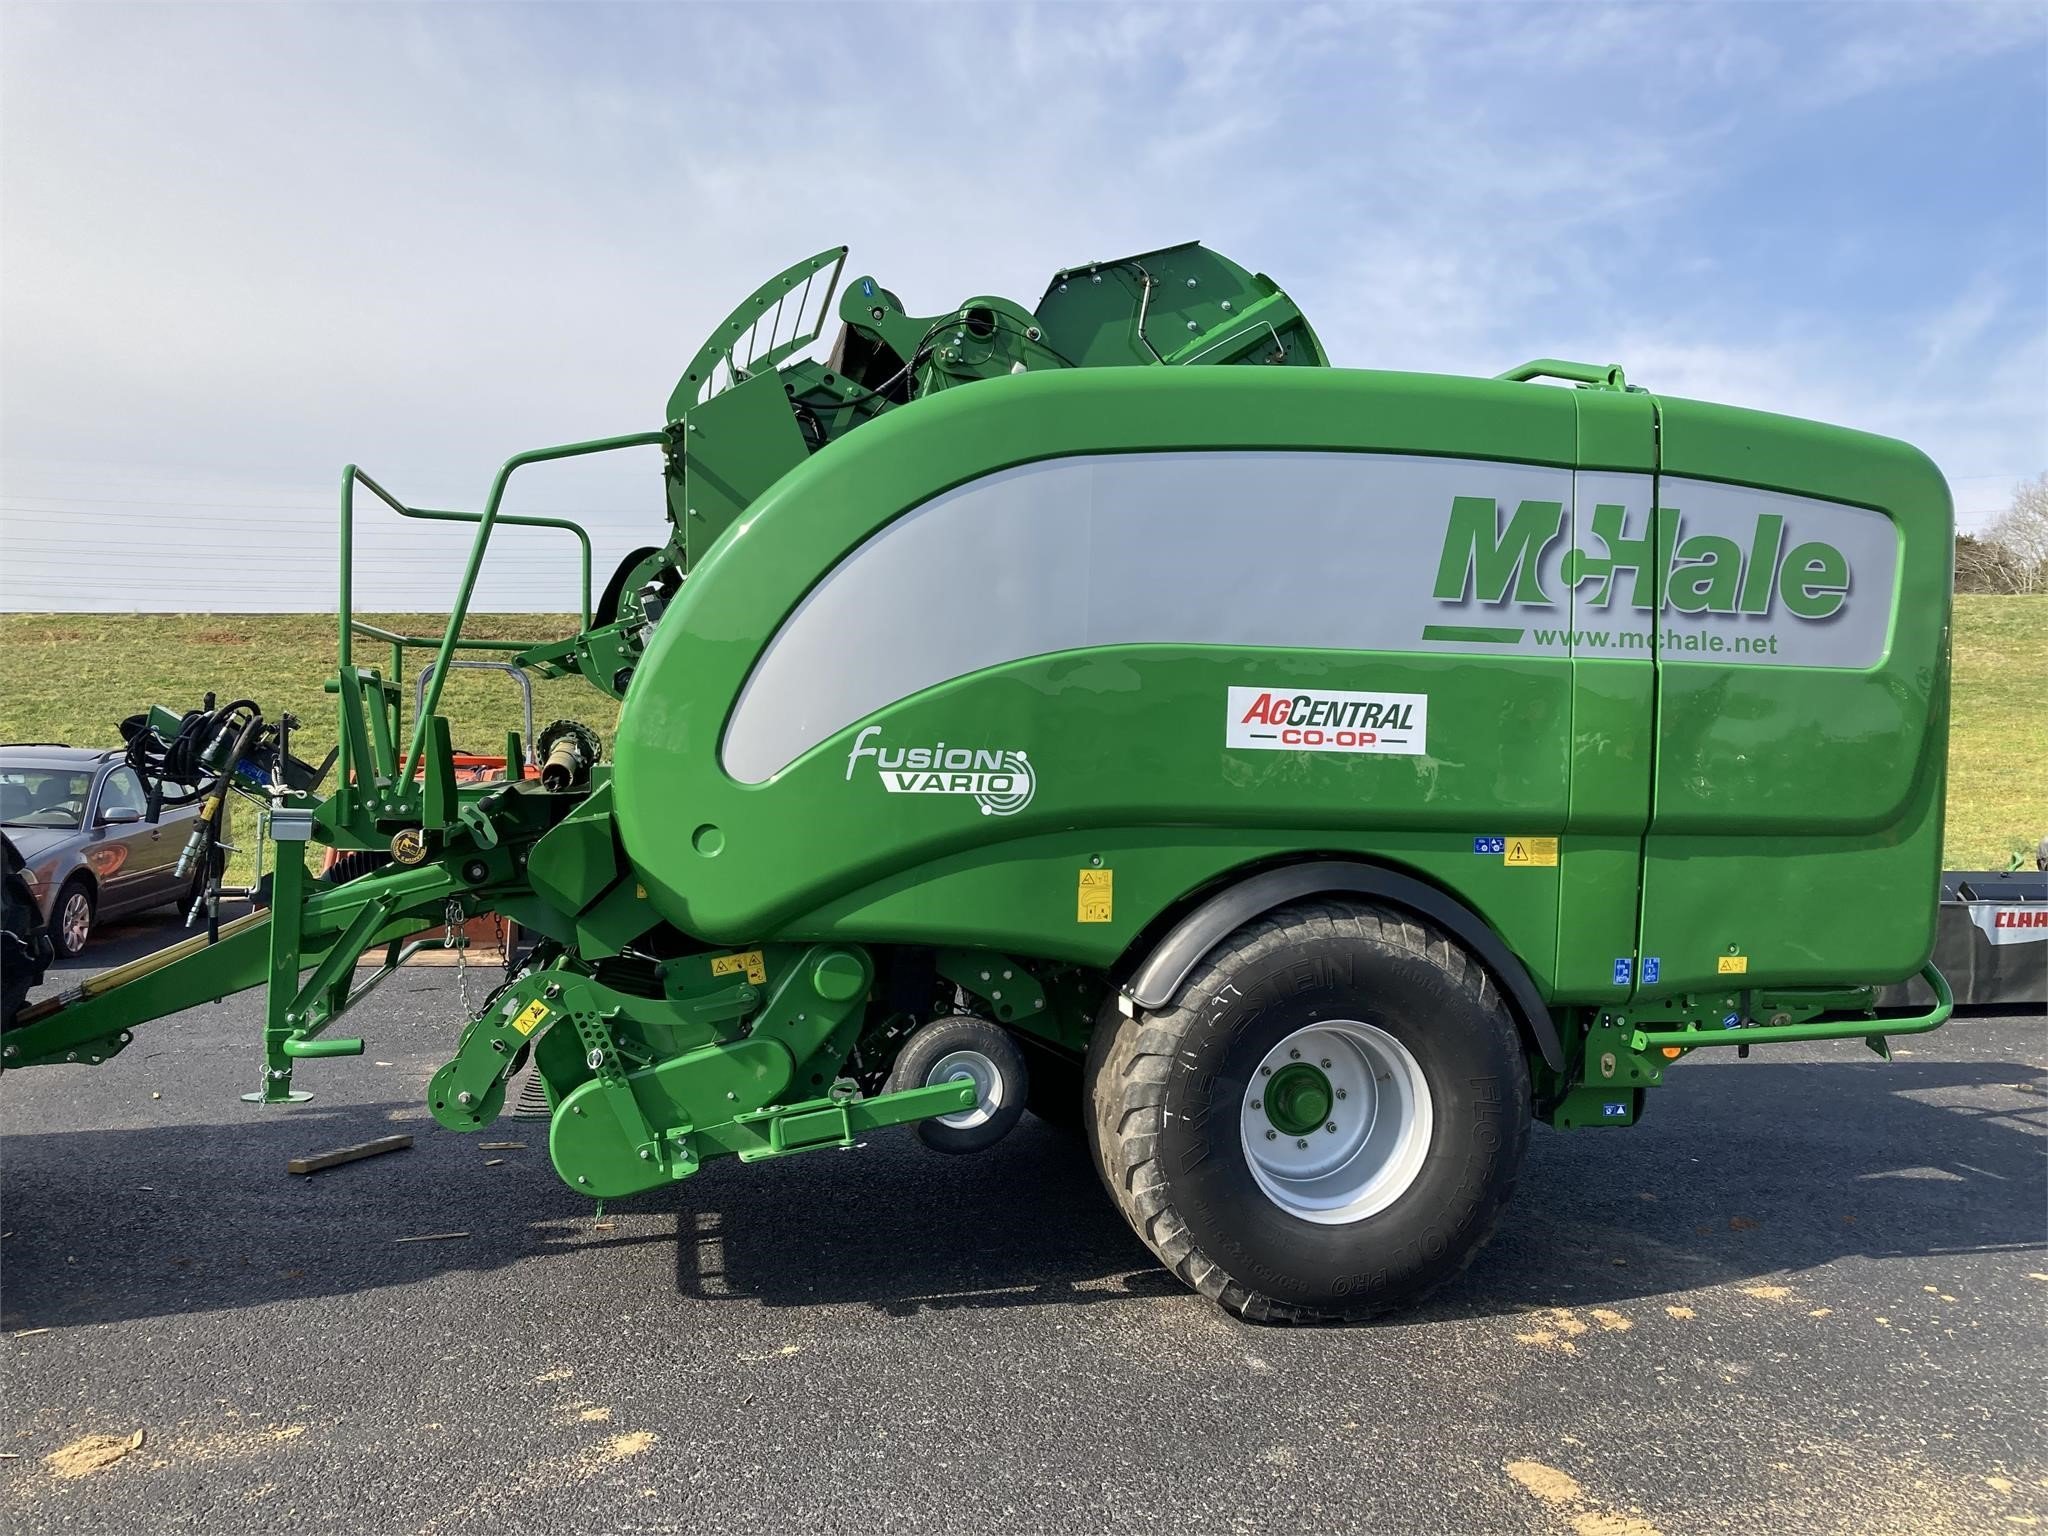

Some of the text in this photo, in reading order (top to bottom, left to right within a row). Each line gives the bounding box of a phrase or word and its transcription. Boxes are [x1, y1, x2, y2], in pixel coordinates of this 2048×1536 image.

[1432, 496, 1851, 618] McHale
[1533, 628, 1778, 654] www.mchale.net
[1281, 729, 1377, 747] CO-OP
[896, 774, 1014, 793] VARIO
